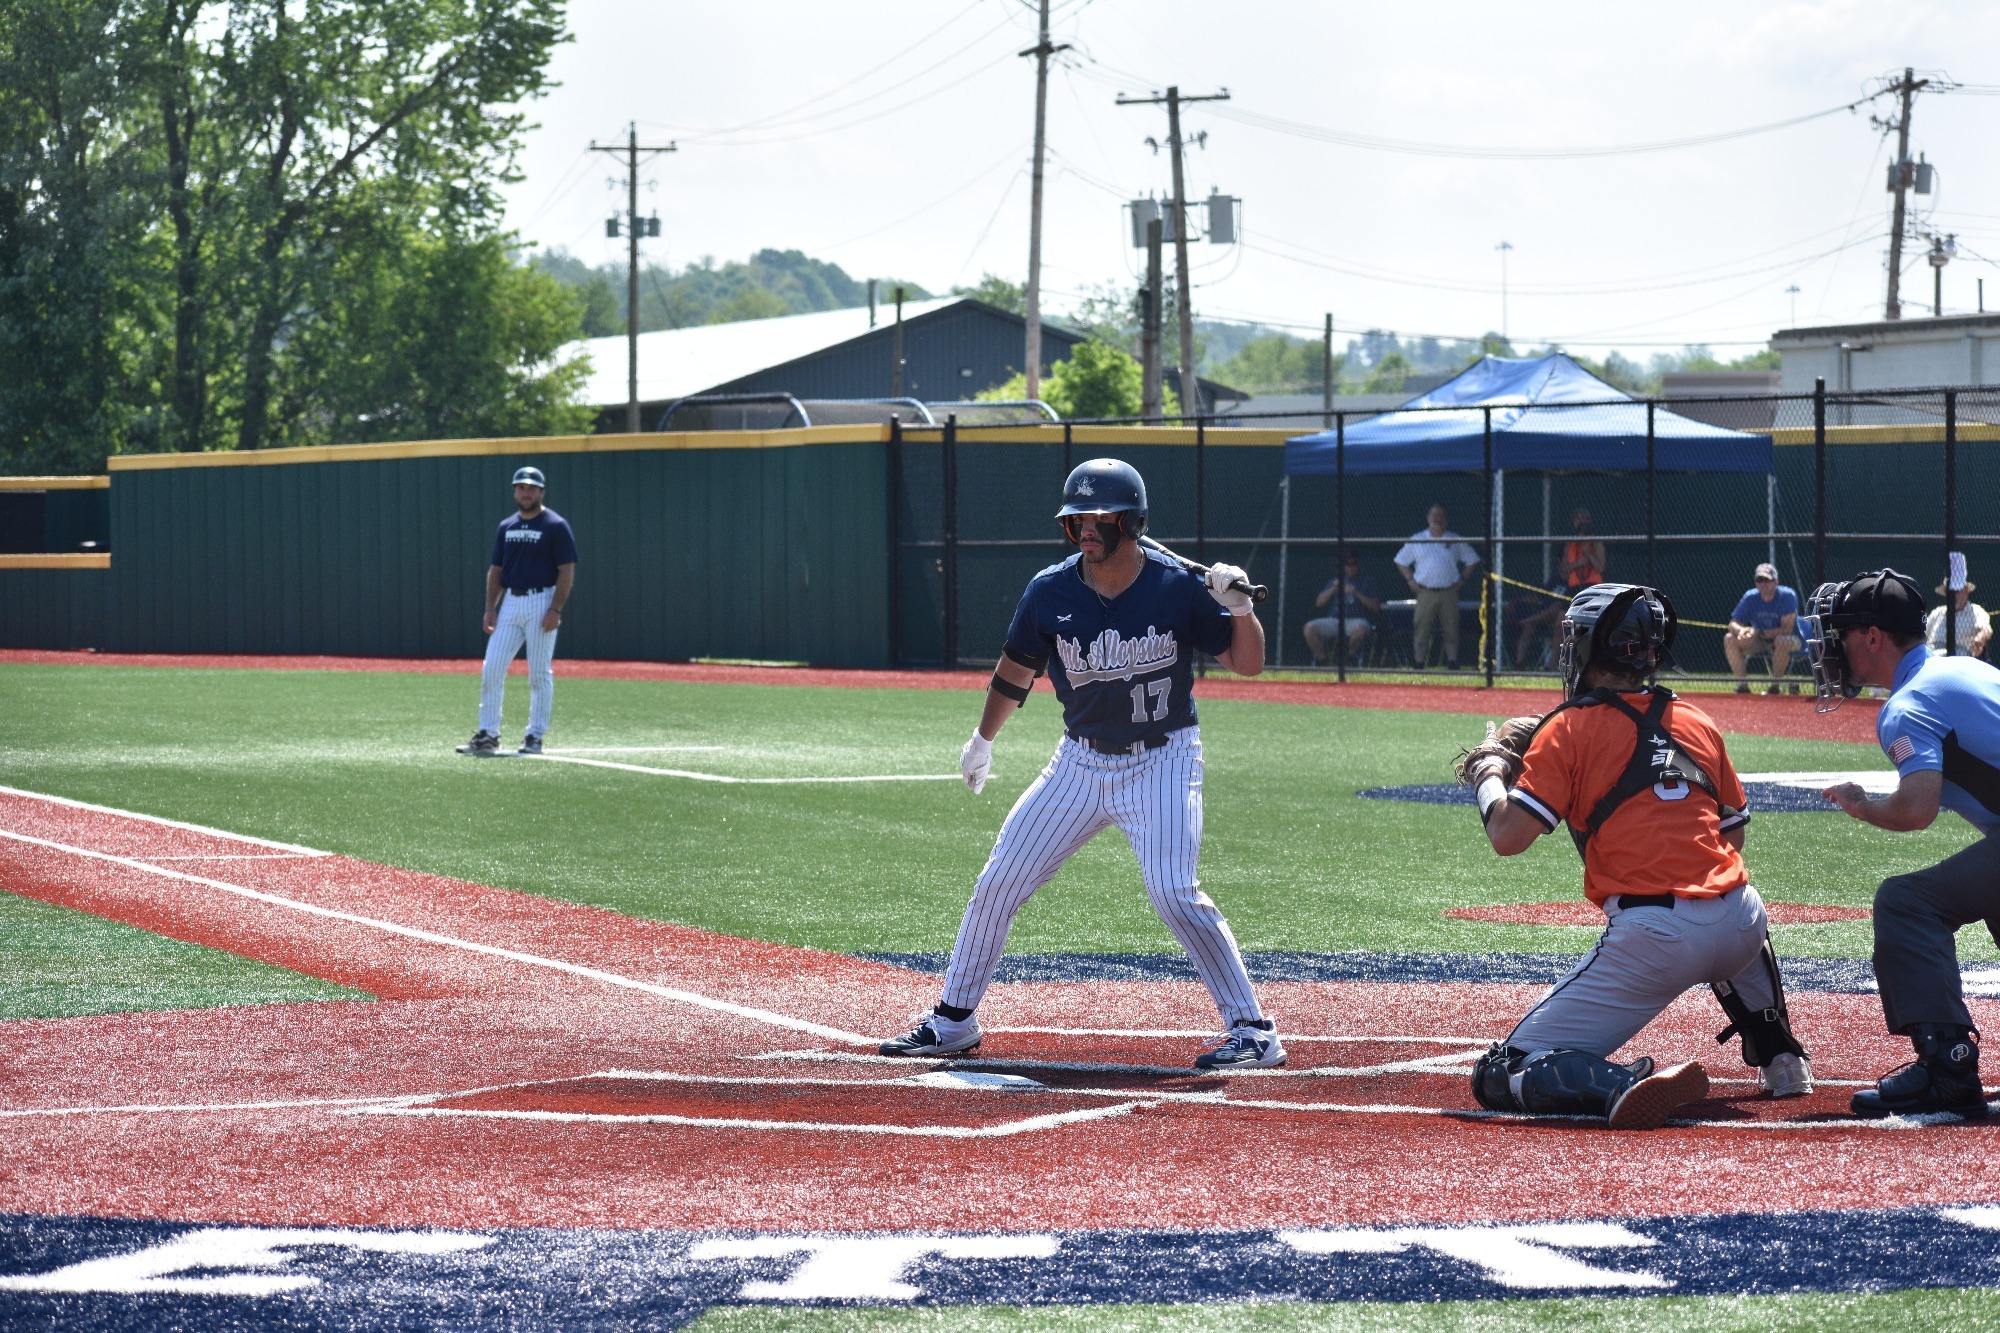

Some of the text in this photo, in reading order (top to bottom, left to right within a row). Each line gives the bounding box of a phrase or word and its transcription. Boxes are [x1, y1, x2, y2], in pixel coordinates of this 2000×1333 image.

[1056, 625, 1177, 681] Mt. Aloysius
[1130, 677, 1172, 723] 17
[0, 1207, 2000, 1300] ETT
